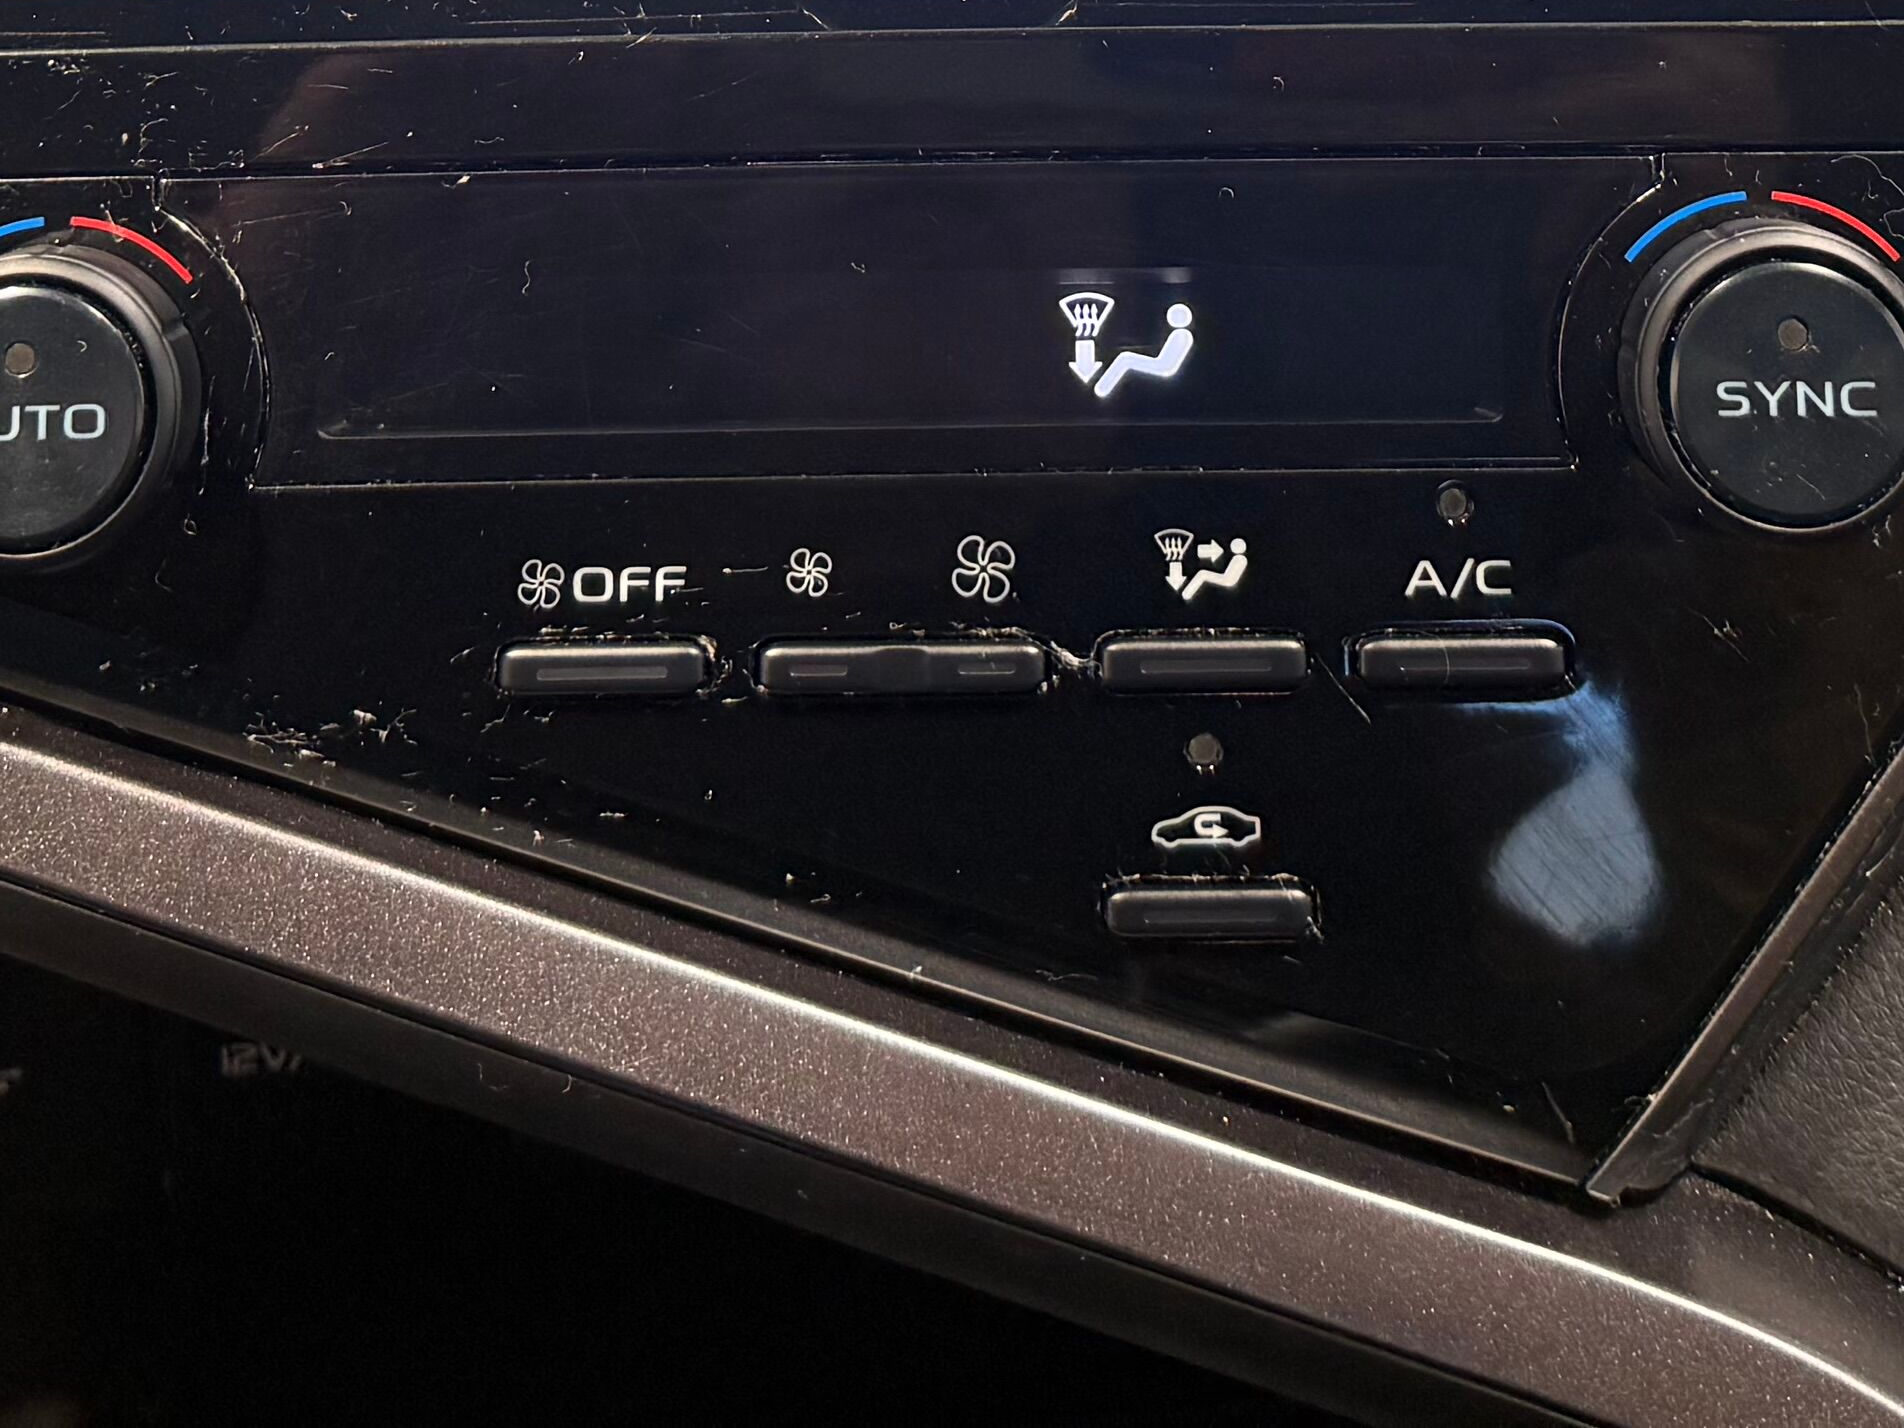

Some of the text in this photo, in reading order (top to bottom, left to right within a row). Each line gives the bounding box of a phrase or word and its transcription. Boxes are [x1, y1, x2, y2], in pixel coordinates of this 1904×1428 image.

[1716, 380, 1878, 418] SYNC
[573, 566, 686, 603] OFF
[1404, 556, 1512, 598] A/C
